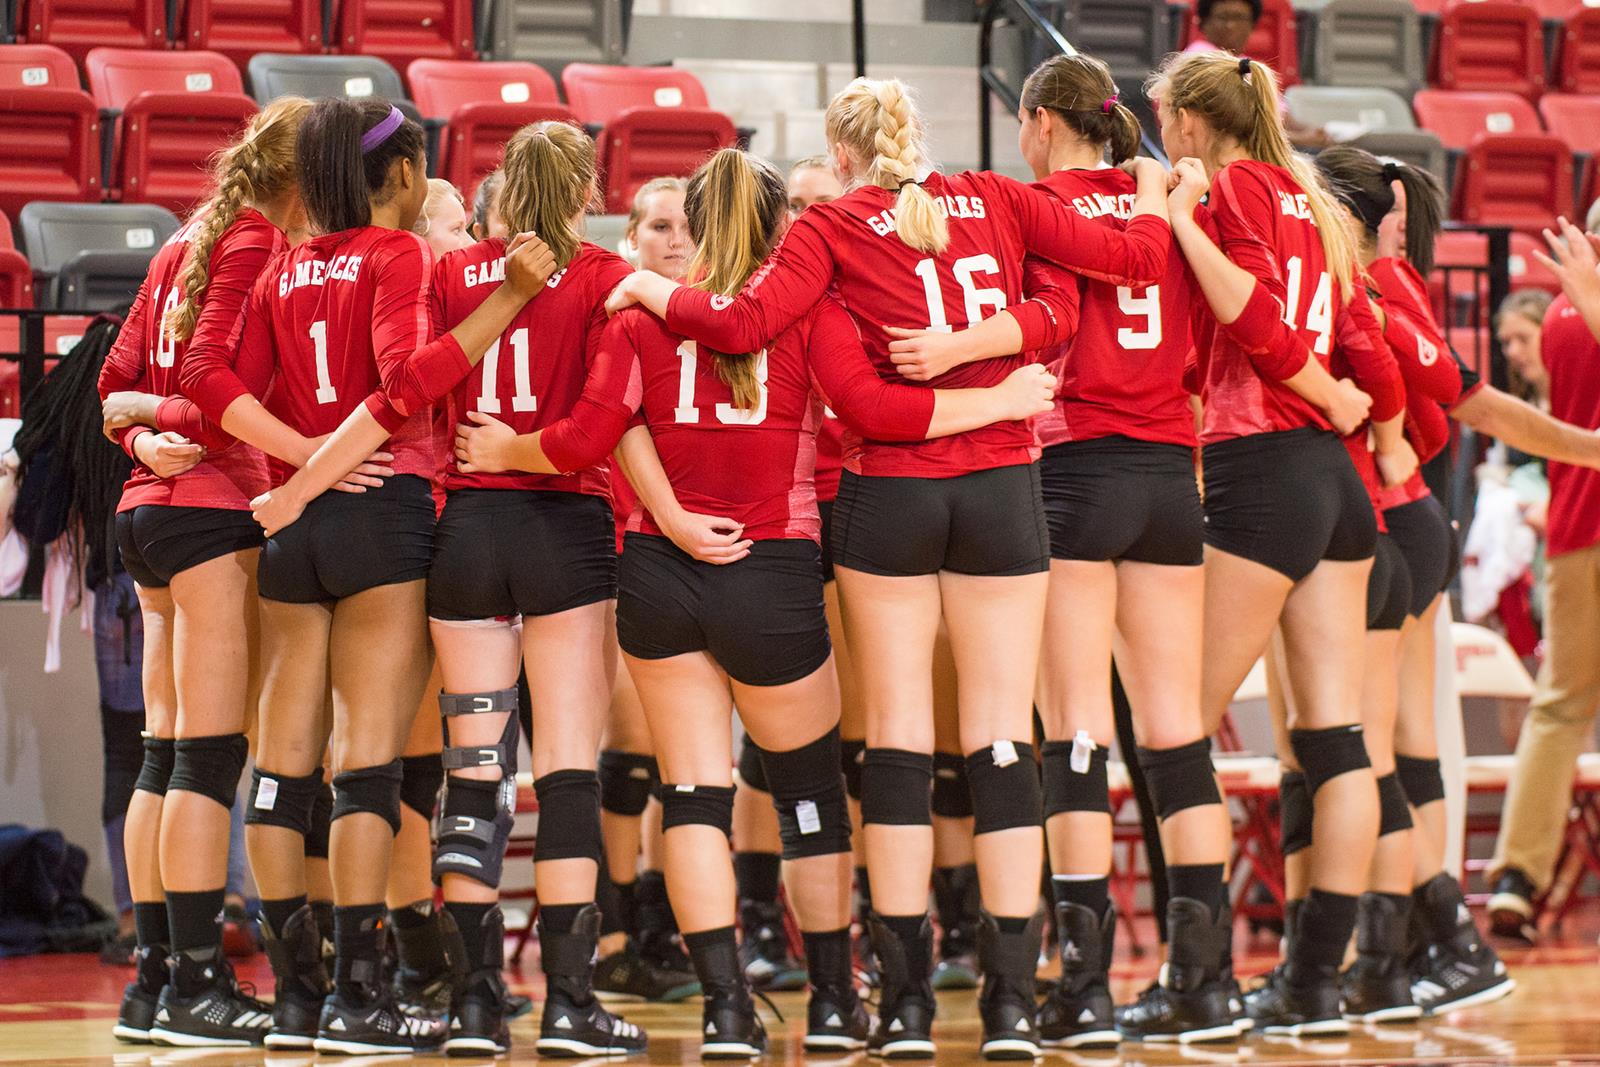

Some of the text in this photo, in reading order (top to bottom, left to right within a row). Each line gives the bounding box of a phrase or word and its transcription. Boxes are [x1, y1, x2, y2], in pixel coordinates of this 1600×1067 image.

[866, 194, 986, 237] GAOCKS
[914, 253, 1007, 334] 16
[1116, 284, 1162, 349] 9
[1283, 256, 1332, 355] 14
[309, 320, 338, 405] 1
[476, 327, 537, 414] 11
[674, 340, 768, 425] 13
